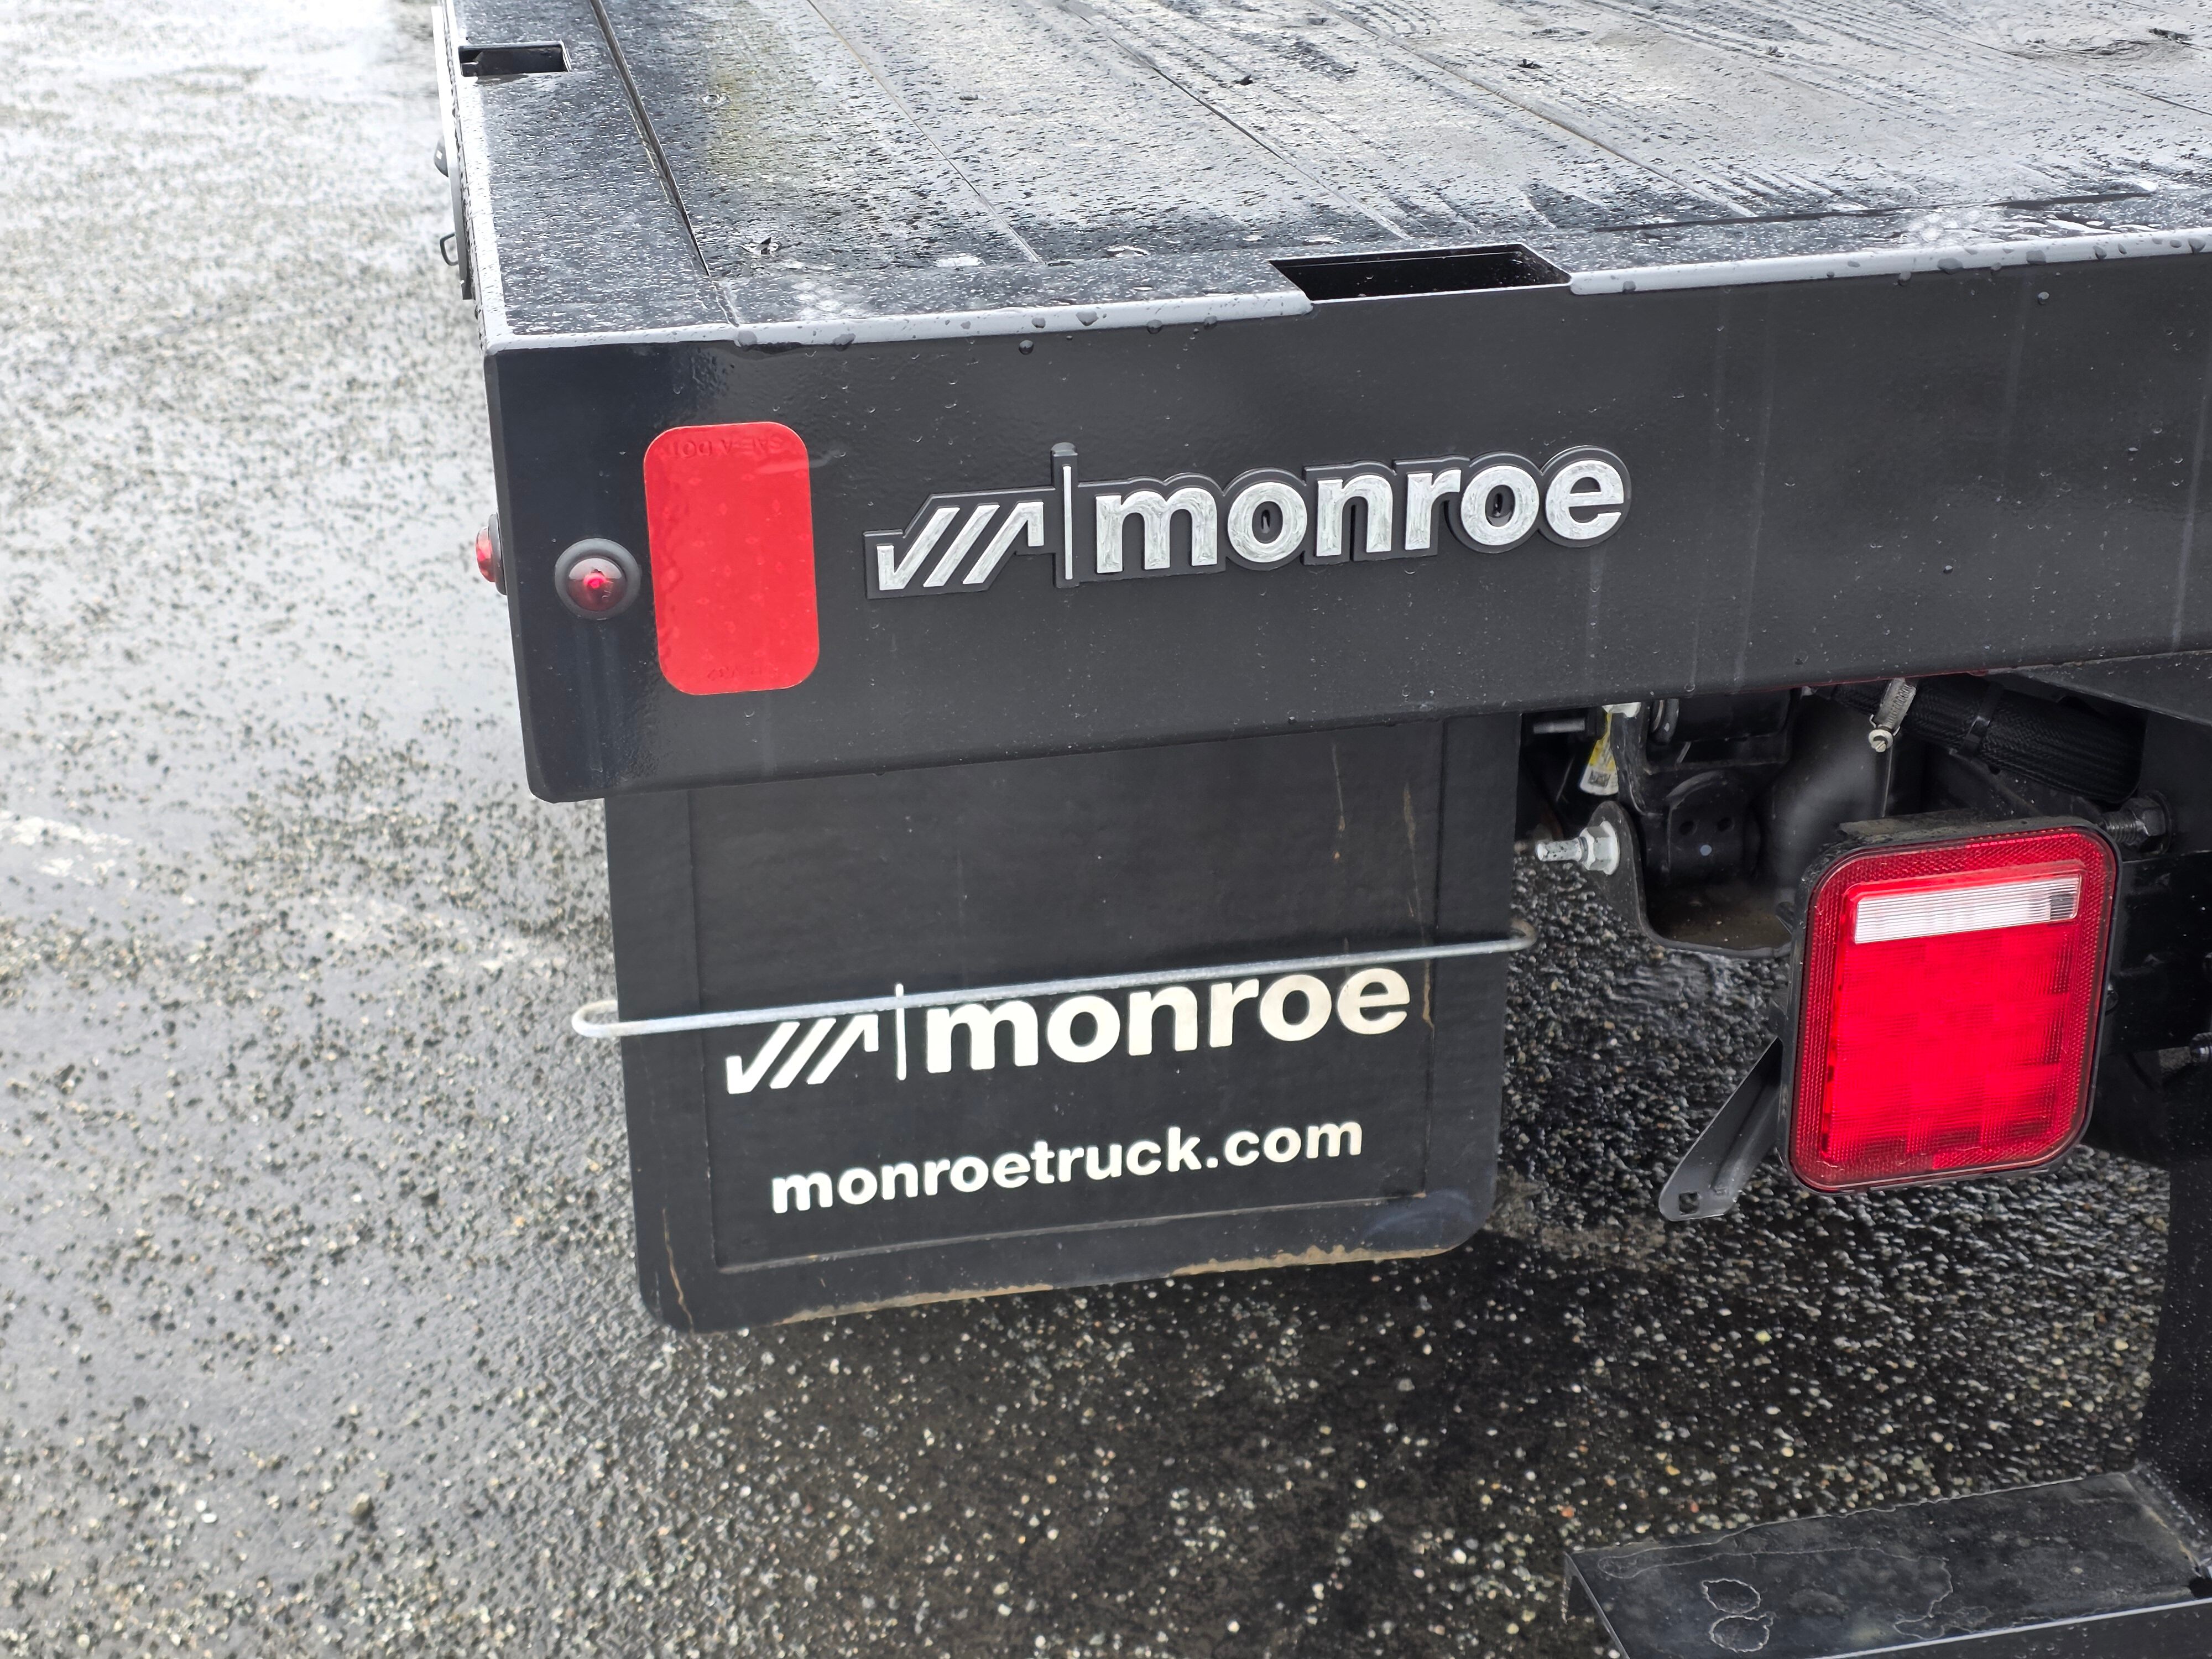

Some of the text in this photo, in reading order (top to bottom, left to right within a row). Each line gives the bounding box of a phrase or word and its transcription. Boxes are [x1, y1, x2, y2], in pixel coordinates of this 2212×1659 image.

[1095, 460, 1624, 573] monroe
[926, 968, 1410, 1074] monroe
[771, 1120, 1362, 1214] monroetruck.com
